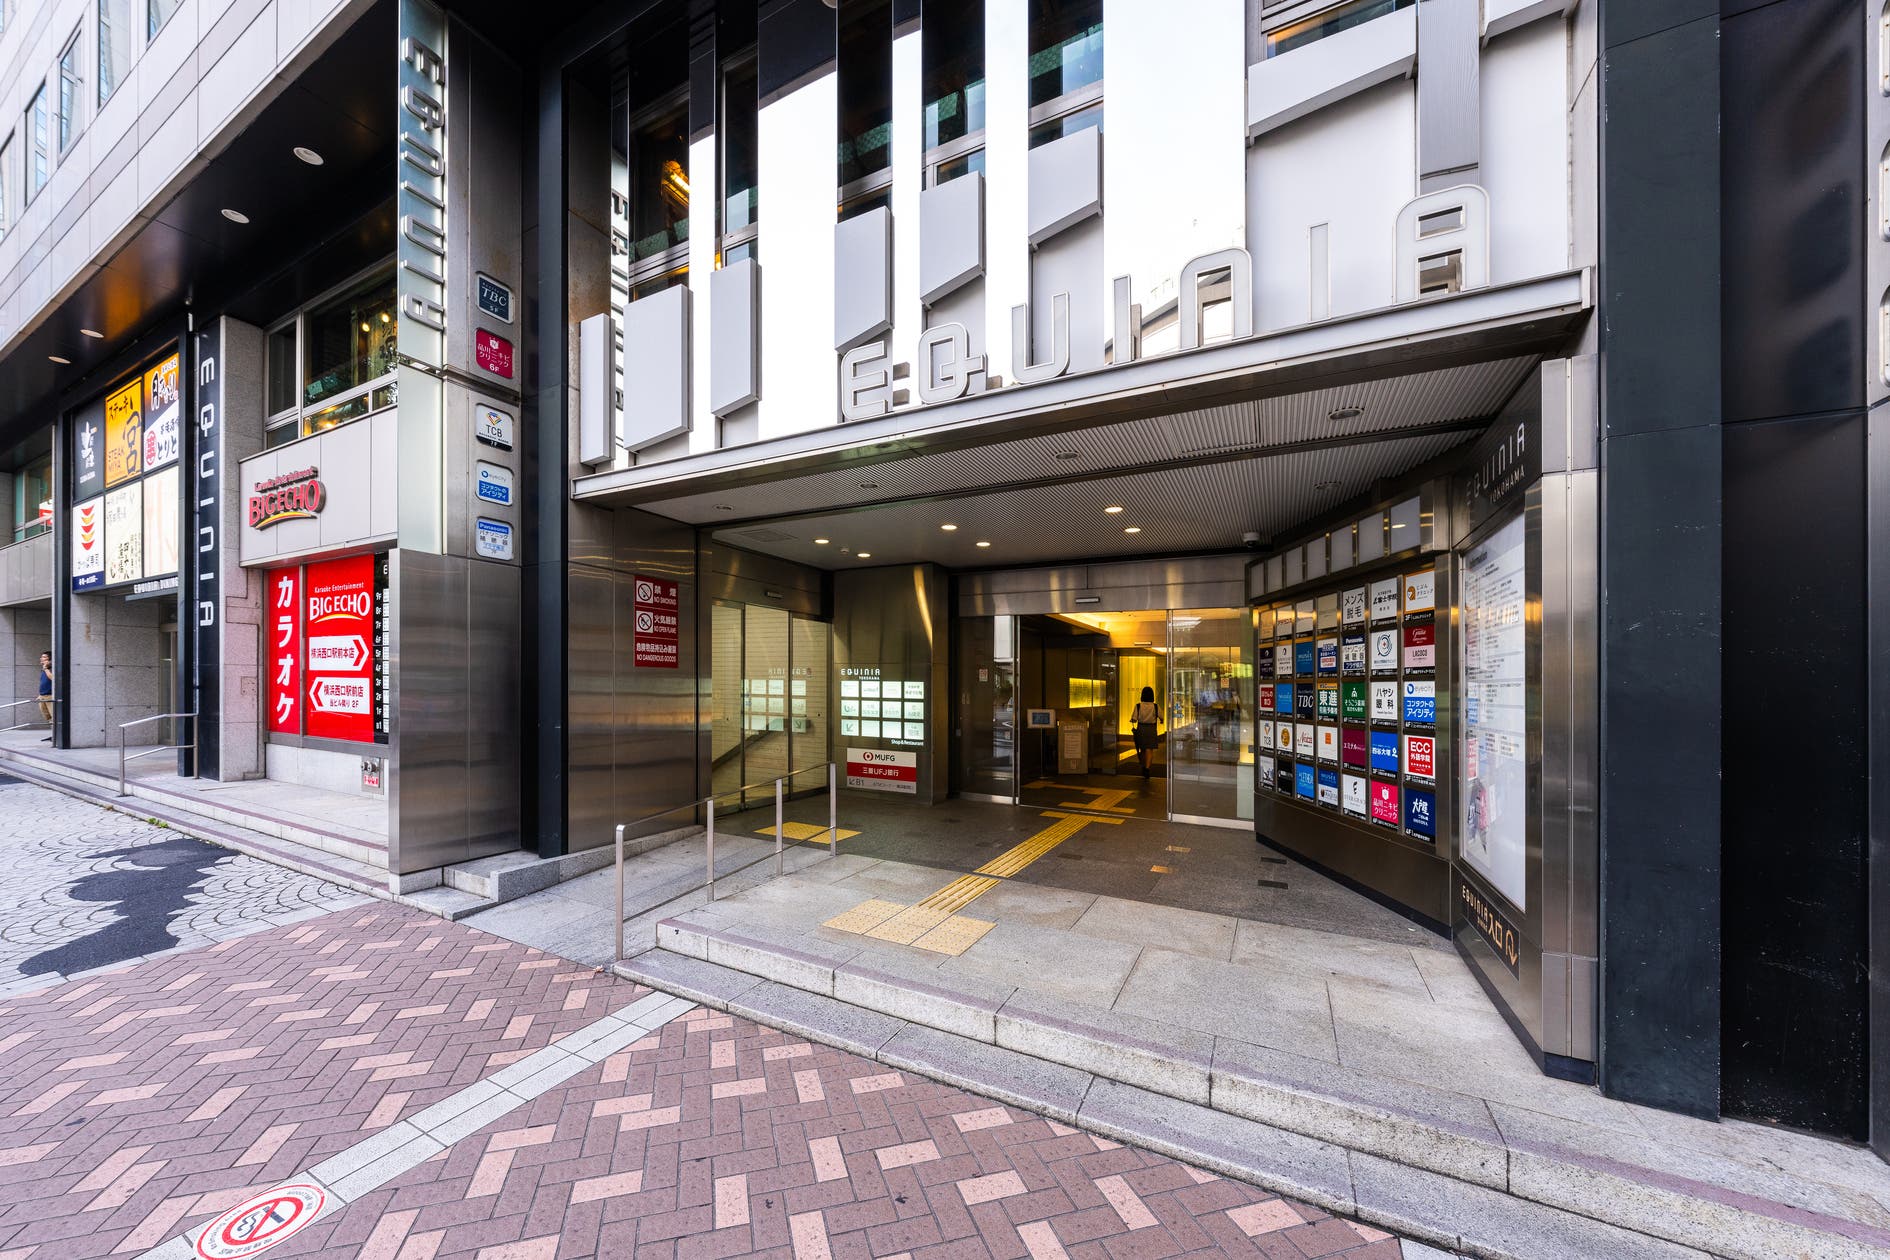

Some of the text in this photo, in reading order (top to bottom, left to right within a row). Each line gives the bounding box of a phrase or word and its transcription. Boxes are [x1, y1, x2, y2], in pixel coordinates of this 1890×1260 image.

[404, 36, 445, 331] EQUINIA
[482, 287, 507, 306] TBC
[840, 184, 1490, 422] EQUINIA
[486, 424, 503, 438] TCB
[1466, 422, 1525, 506] EQUINIA
[200, 356, 214, 627] EQUINIA
[1490, 464, 1525, 505] YOKOHAMA
[249, 479, 320, 527] BIG ECHO
[479, 522, 509, 534] Panasonic
[314, 581, 364, 594] Karaoke Entertainment
[1344, 591, 1364, 606] メンズ
[309, 591, 371, 621] BIG ECHO
[276, 575, 295, 725] カラオケ
[311, 647, 355, 659] 横浜西口駅前本店
[840, 668, 880, 676] EQUINIA
[323, 684, 364, 698] 横浜西口駅前店
[1319, 690, 1338, 706] 東進
[1376, 688, 1394, 697] ハヤシ
[1297, 695, 1314, 708] TBC
[1376, 699, 1394, 709] 眼科
[1406, 700, 1435, 708] コンタクトの
[1406, 708, 1434, 718] アイシティ
[1410, 741, 1431, 754] ECC
[874, 753, 896, 762] MUFG
[862, 766, 900, 777] 三菱UFJ銀行
[1374, 807, 1398, 820] クリニック
[1462, 884, 1488, 922] EQUINIA
